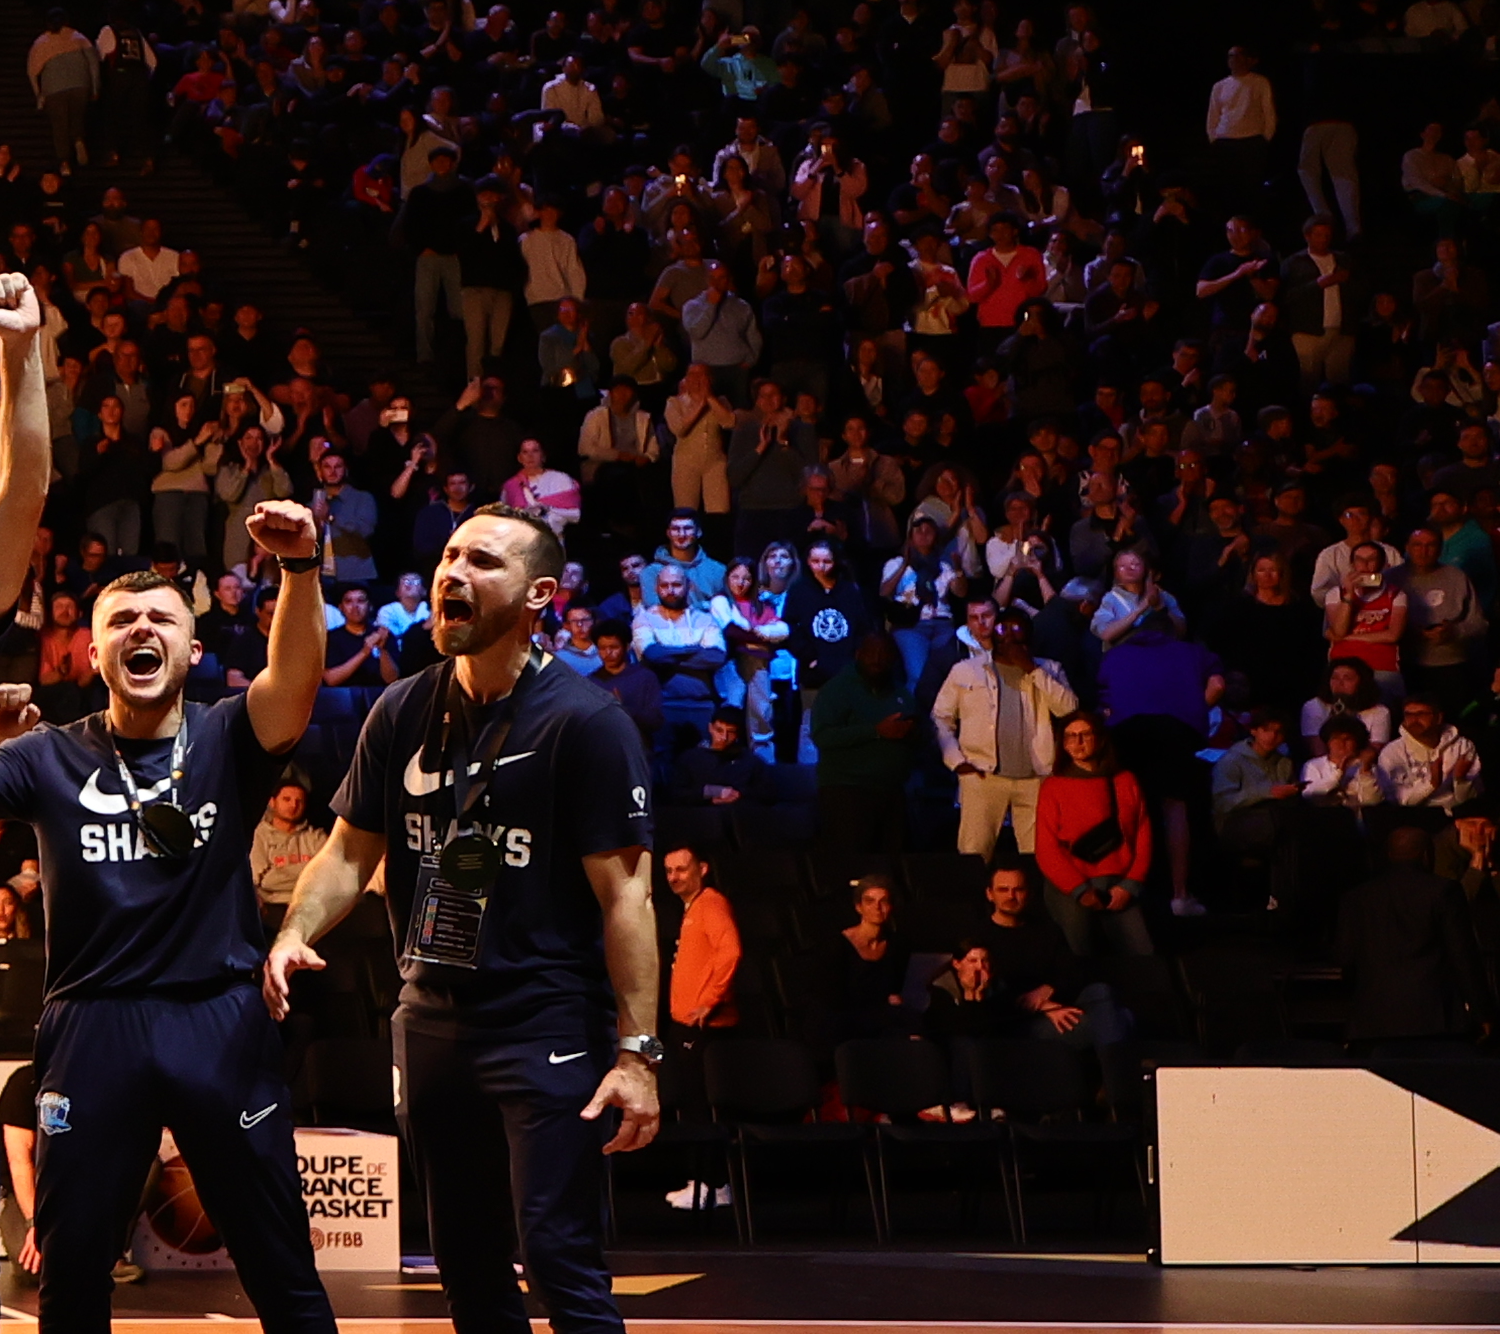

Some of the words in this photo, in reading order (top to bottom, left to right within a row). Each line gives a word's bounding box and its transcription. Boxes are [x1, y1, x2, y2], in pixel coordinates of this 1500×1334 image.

[366, 1162, 388, 1177] DE
[308, 1199, 393, 1218] ASKET
[326, 1231, 364, 1248] FFBB
